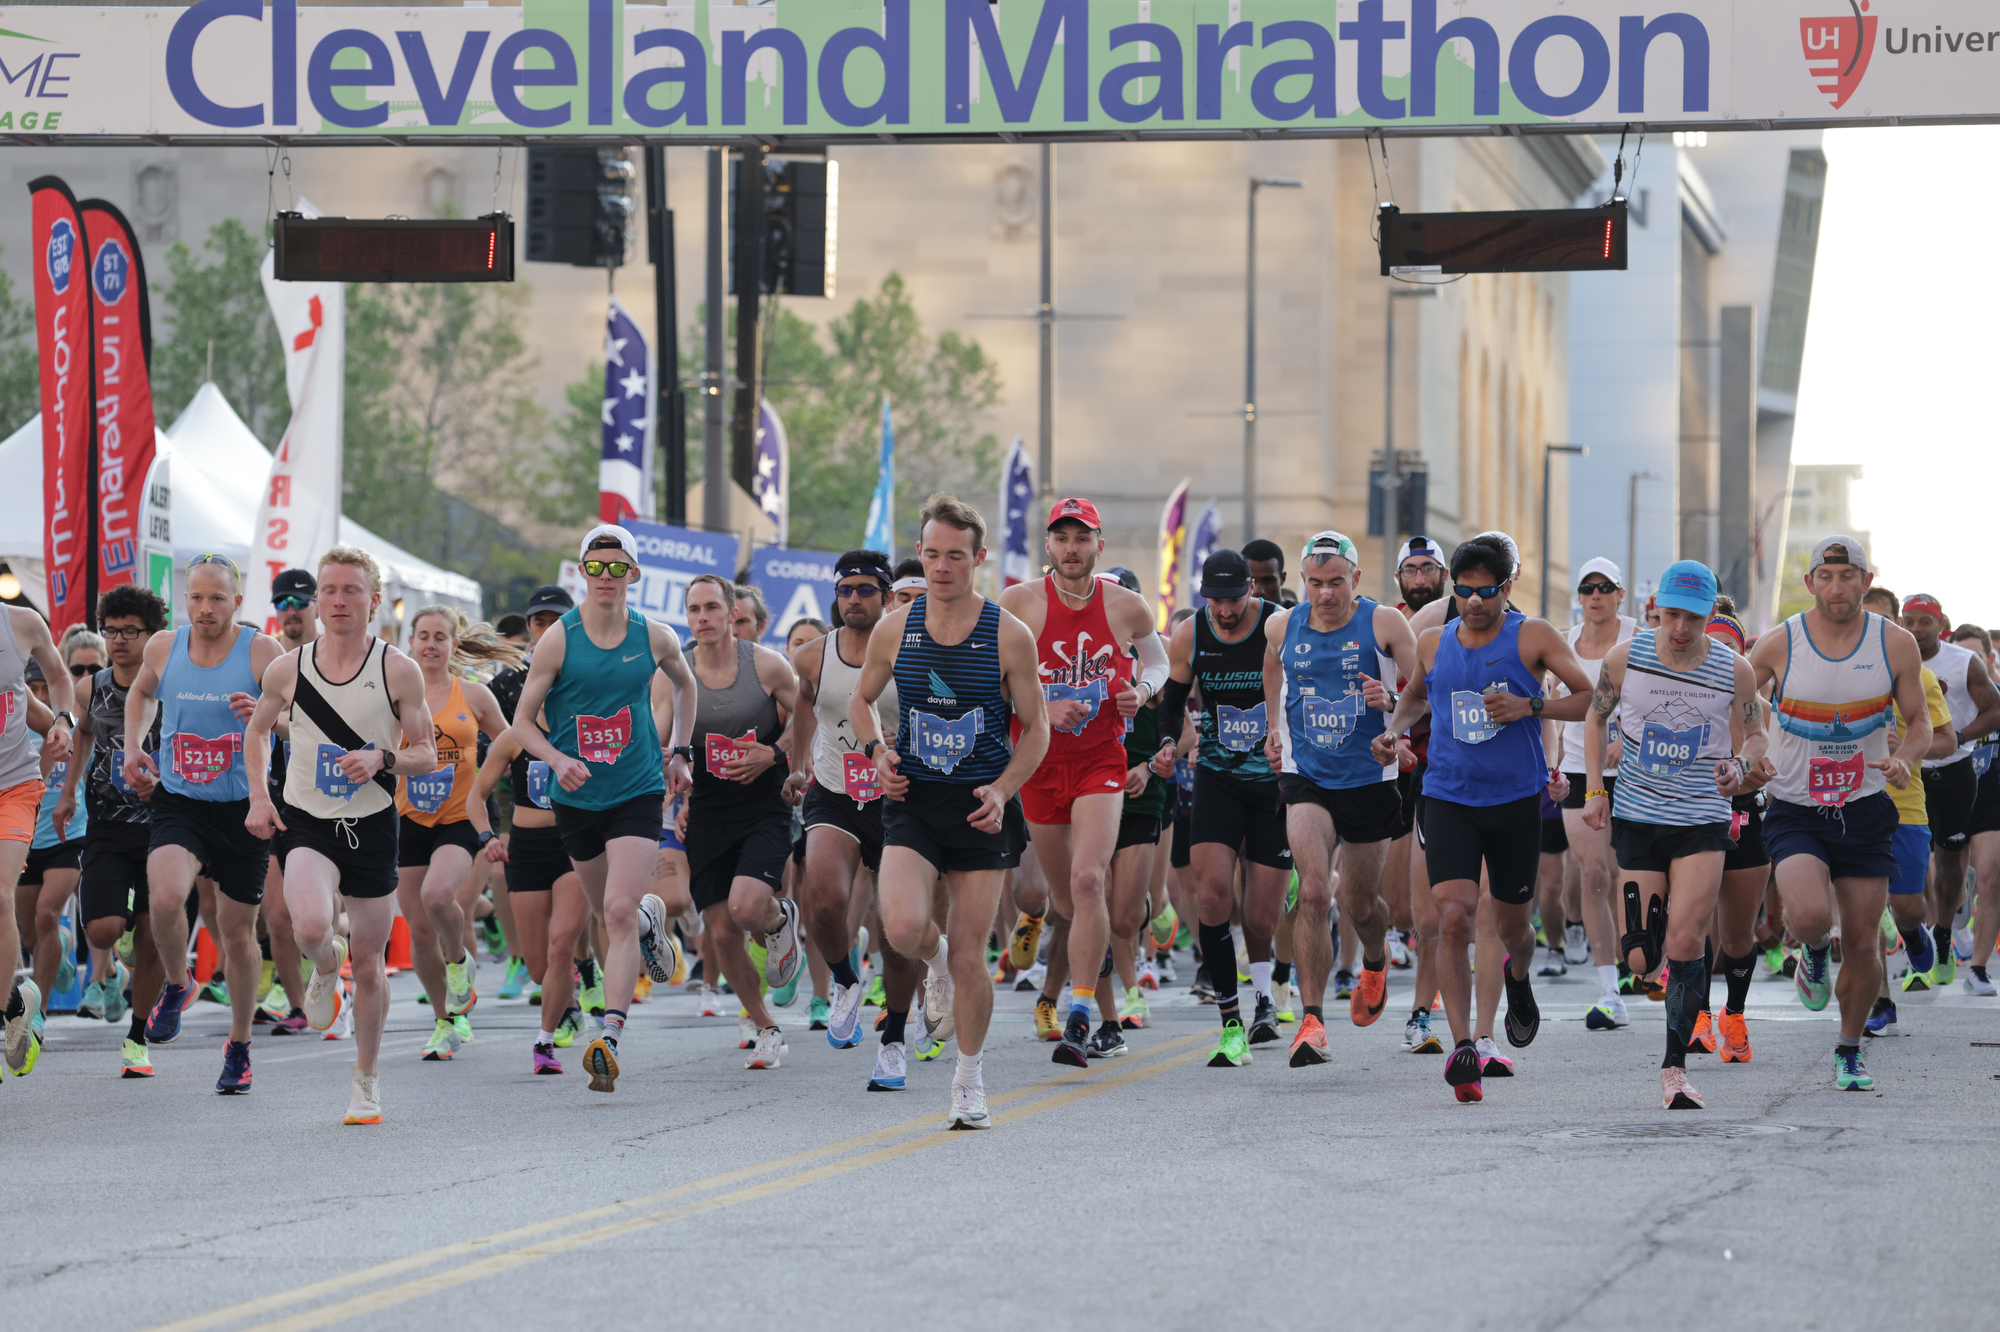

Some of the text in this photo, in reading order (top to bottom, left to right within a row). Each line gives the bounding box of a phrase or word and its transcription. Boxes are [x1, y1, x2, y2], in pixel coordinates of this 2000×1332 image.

[1886, 25, 2000, 54] Univer
[165, 0, 1709, 128] Cleveland Marathon
[0, 111, 62, 130] AGE
[149, 513, 171, 543] LEVEL
[634, 534, 718, 566] CORRAL
[766, 559, 834, 582] CORRA
[627, 577, 688, 615] ELIT
[772, 584, 824, 638] A
[906, 634, 921, 643] DTC
[1052, 650, 1107, 684] nike
[927, 696, 956, 705] dayton
[1650, 689, 1716, 699] ANTELOPE CHILDREN
[1309, 713, 1346, 728] 1001
[1459, 708, 1494, 724] 101
[1223, 720, 1259, 734] 2402
[583, 727, 623, 744] 3351
[922, 731, 966, 749] 1943
[437, 751, 460, 760] CING
[712, 749, 748, 762] 5647
[1647, 740, 1690, 759] 1008
[184, 751, 225, 765] 5214
[322, 762, 343, 778] 10
[850, 768, 878, 783] 547
[1814, 771, 1856, 787] 3137
[411, 781, 445, 795] 1012
